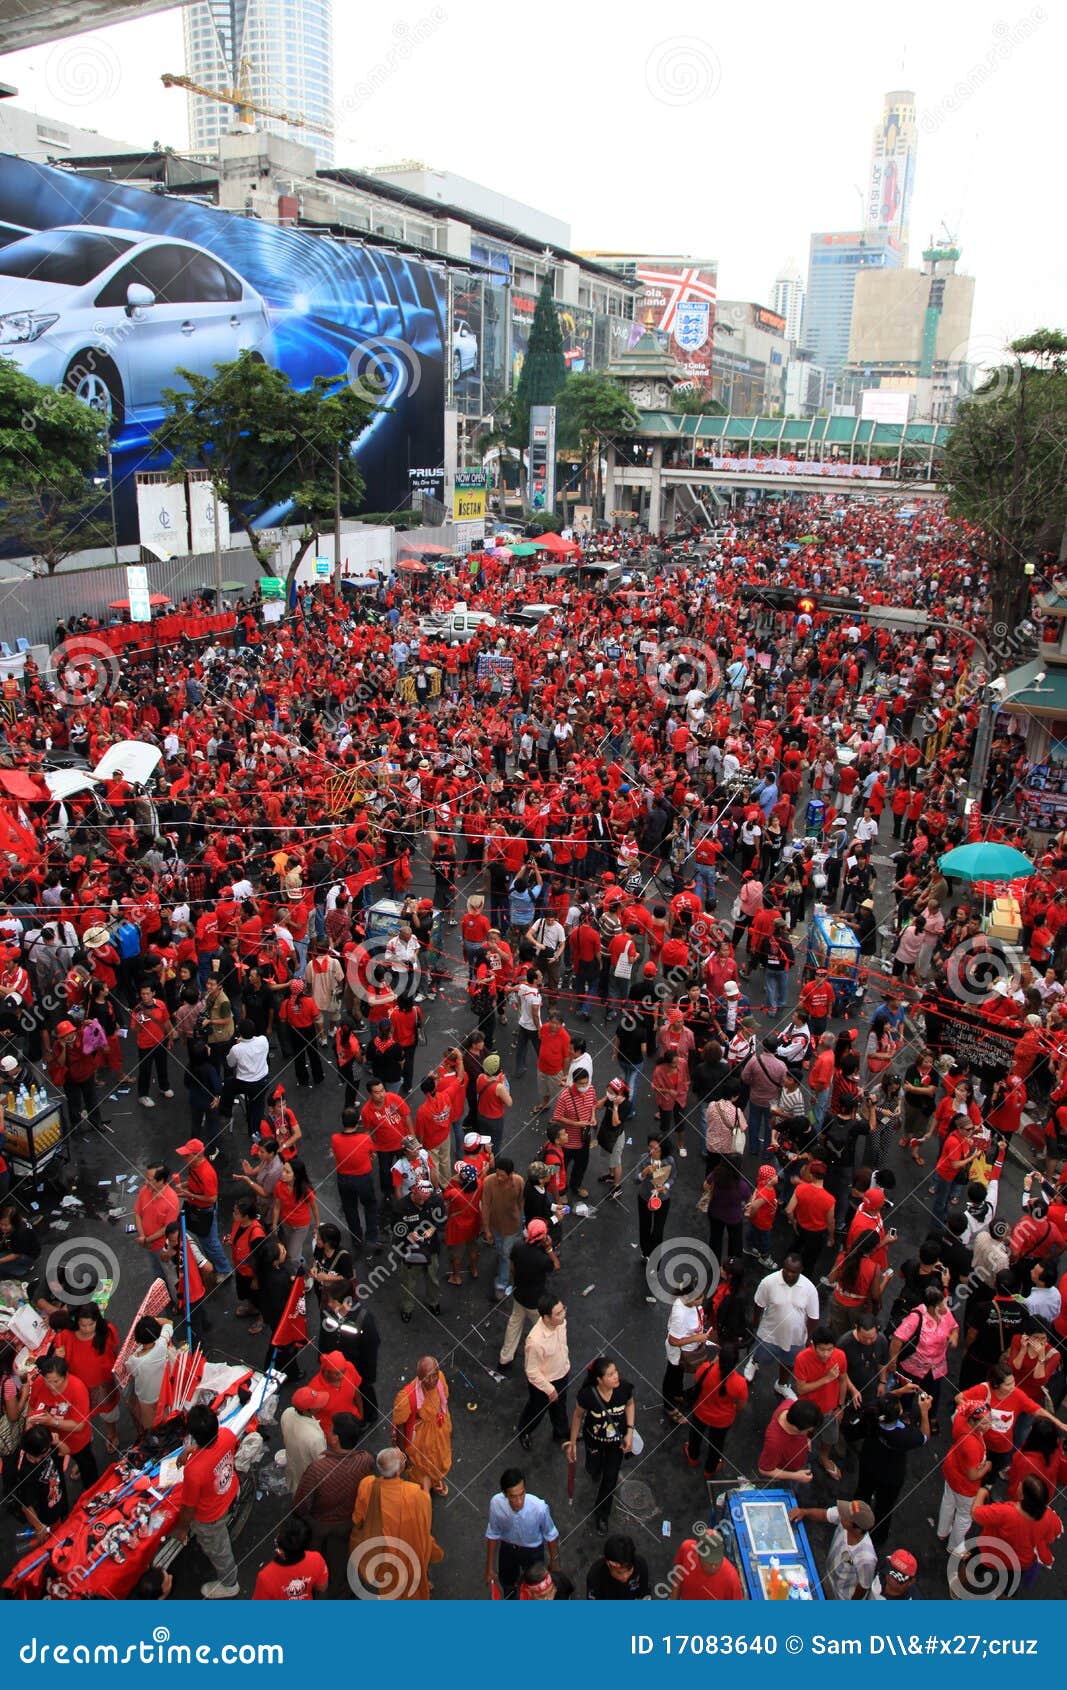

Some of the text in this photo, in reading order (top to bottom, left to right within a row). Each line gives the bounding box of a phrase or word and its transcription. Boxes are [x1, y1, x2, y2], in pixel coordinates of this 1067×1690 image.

[408, 468, 444, 478] PRIUS
[456, 472, 486, 483] NOW OPEN
